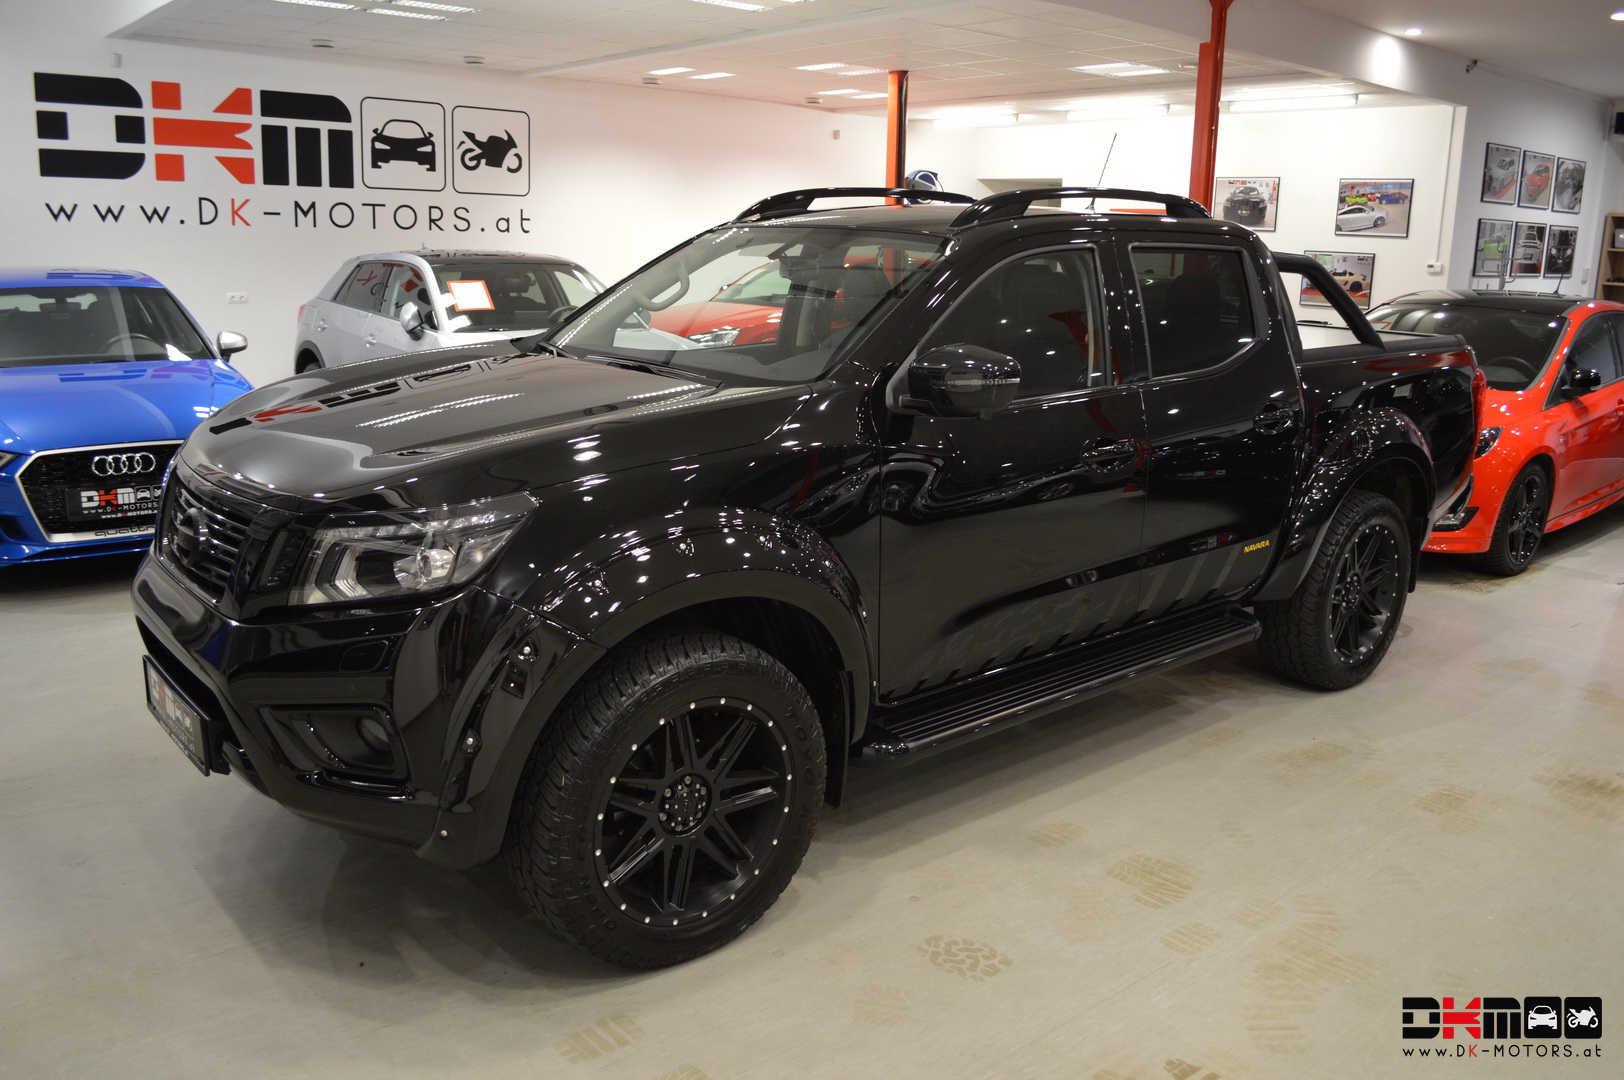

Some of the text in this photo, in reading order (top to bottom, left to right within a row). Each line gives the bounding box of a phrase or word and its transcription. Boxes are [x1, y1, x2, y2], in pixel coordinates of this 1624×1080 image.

[45, 196, 531, 234] www.DK-MOTORS.at
[83, 502, 158, 514] www.DK-MOTORS
[101, 509, 158, 519] www.DK-MOTORS.a
[95, 525, 156, 537] quattr
[1243, 539, 1270, 553] NAVARA
